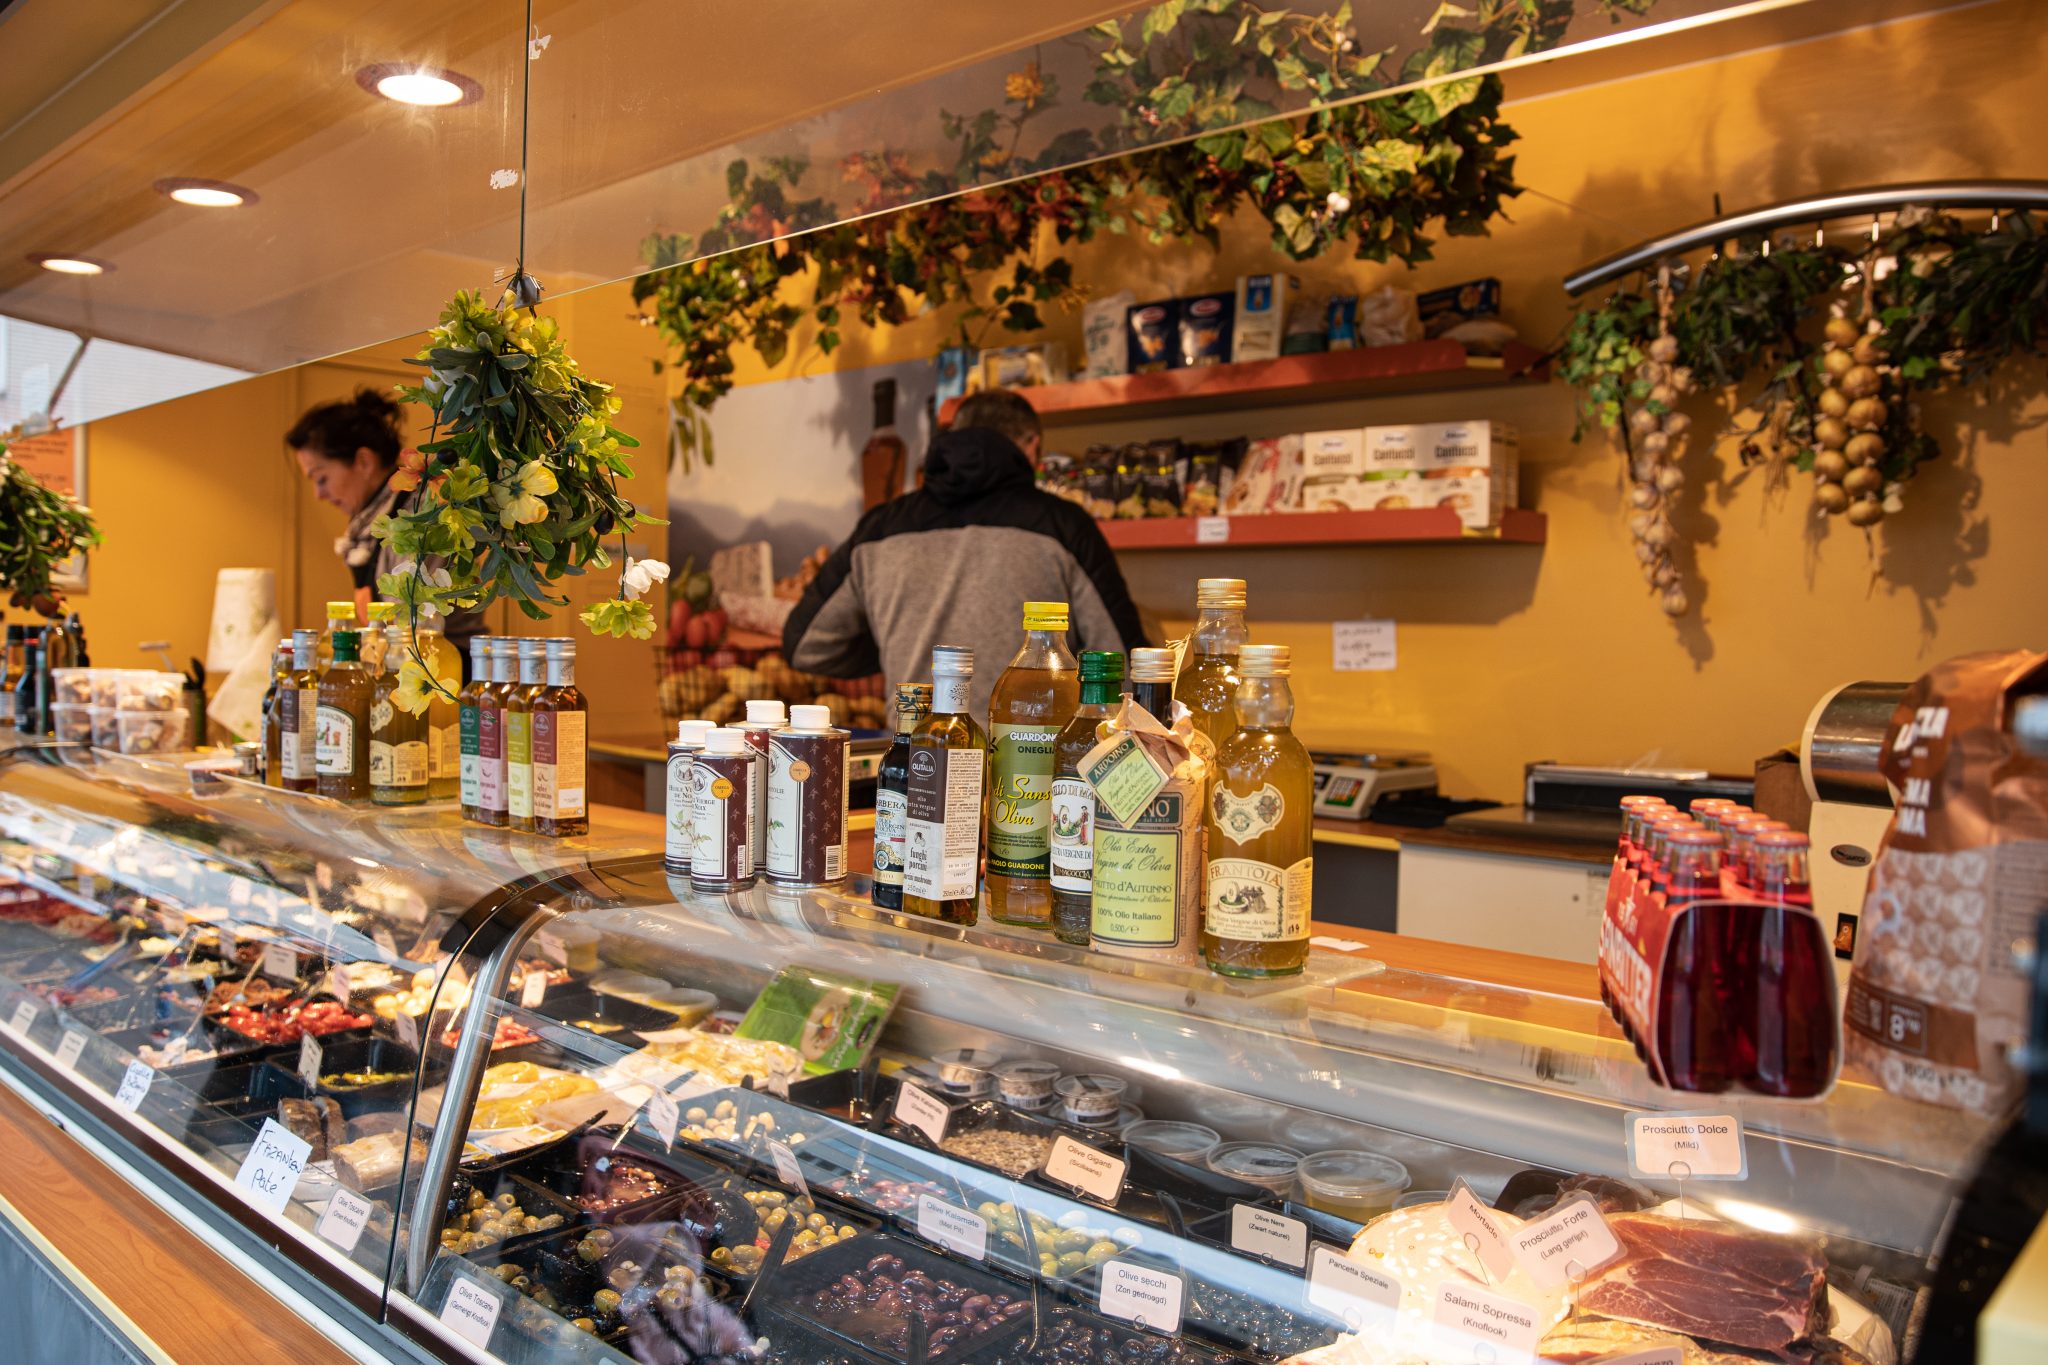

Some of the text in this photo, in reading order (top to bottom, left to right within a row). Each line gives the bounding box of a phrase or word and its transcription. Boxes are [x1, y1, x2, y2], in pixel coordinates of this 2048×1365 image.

[1018, 746, 1054, 754] ONEGLI
[912, 763, 934, 772] OLITALIA
[1093, 743, 1129, 779] ARDOINO
[1007, 776, 1053, 800] Sans
[995, 800, 1034, 825] Oliva
[1063, 848, 1084, 860] VERGINE
[1102, 835, 1157, 854] Olio Extra
[1007, 862, 1045, 870] GUARDONE
[1122, 858, 1136, 870] di
[1138, 855, 1172, 871] Oliva
[1210, 863, 1281, 887] FRANTOIA
[1097, 907, 1162, 921] 100% Olio Italiano
[1642, 1125, 1729, 1134] Prosciutto Dolce
[1067, 1145, 1086, 1158] Olive
[1674, 1141, 1700, 1150] (Mild)
[927, 1201, 980, 1228] Olive Kalamate
[1254, 1213, 1270, 1223] Olive
[1248, 1222, 1267, 1233] (Zwart
[1519, 1208, 1588, 1251] Prosciutto Forte
[1540, 1230, 1589, 1260] (Lang gerijpt)
[1118, 1269, 1167, 1289] Olive secchi
[1328, 1257, 1389, 1290] Pancetta Speziale
[458, 1286, 494, 1313] Olive Toscane
[1115, 1284, 1167, 1306] (Zon gedroogd)
[1444, 1292, 1532, 1329] Salami Sopressa
[1462, 1316, 1508, 1339] (Knoflook)
